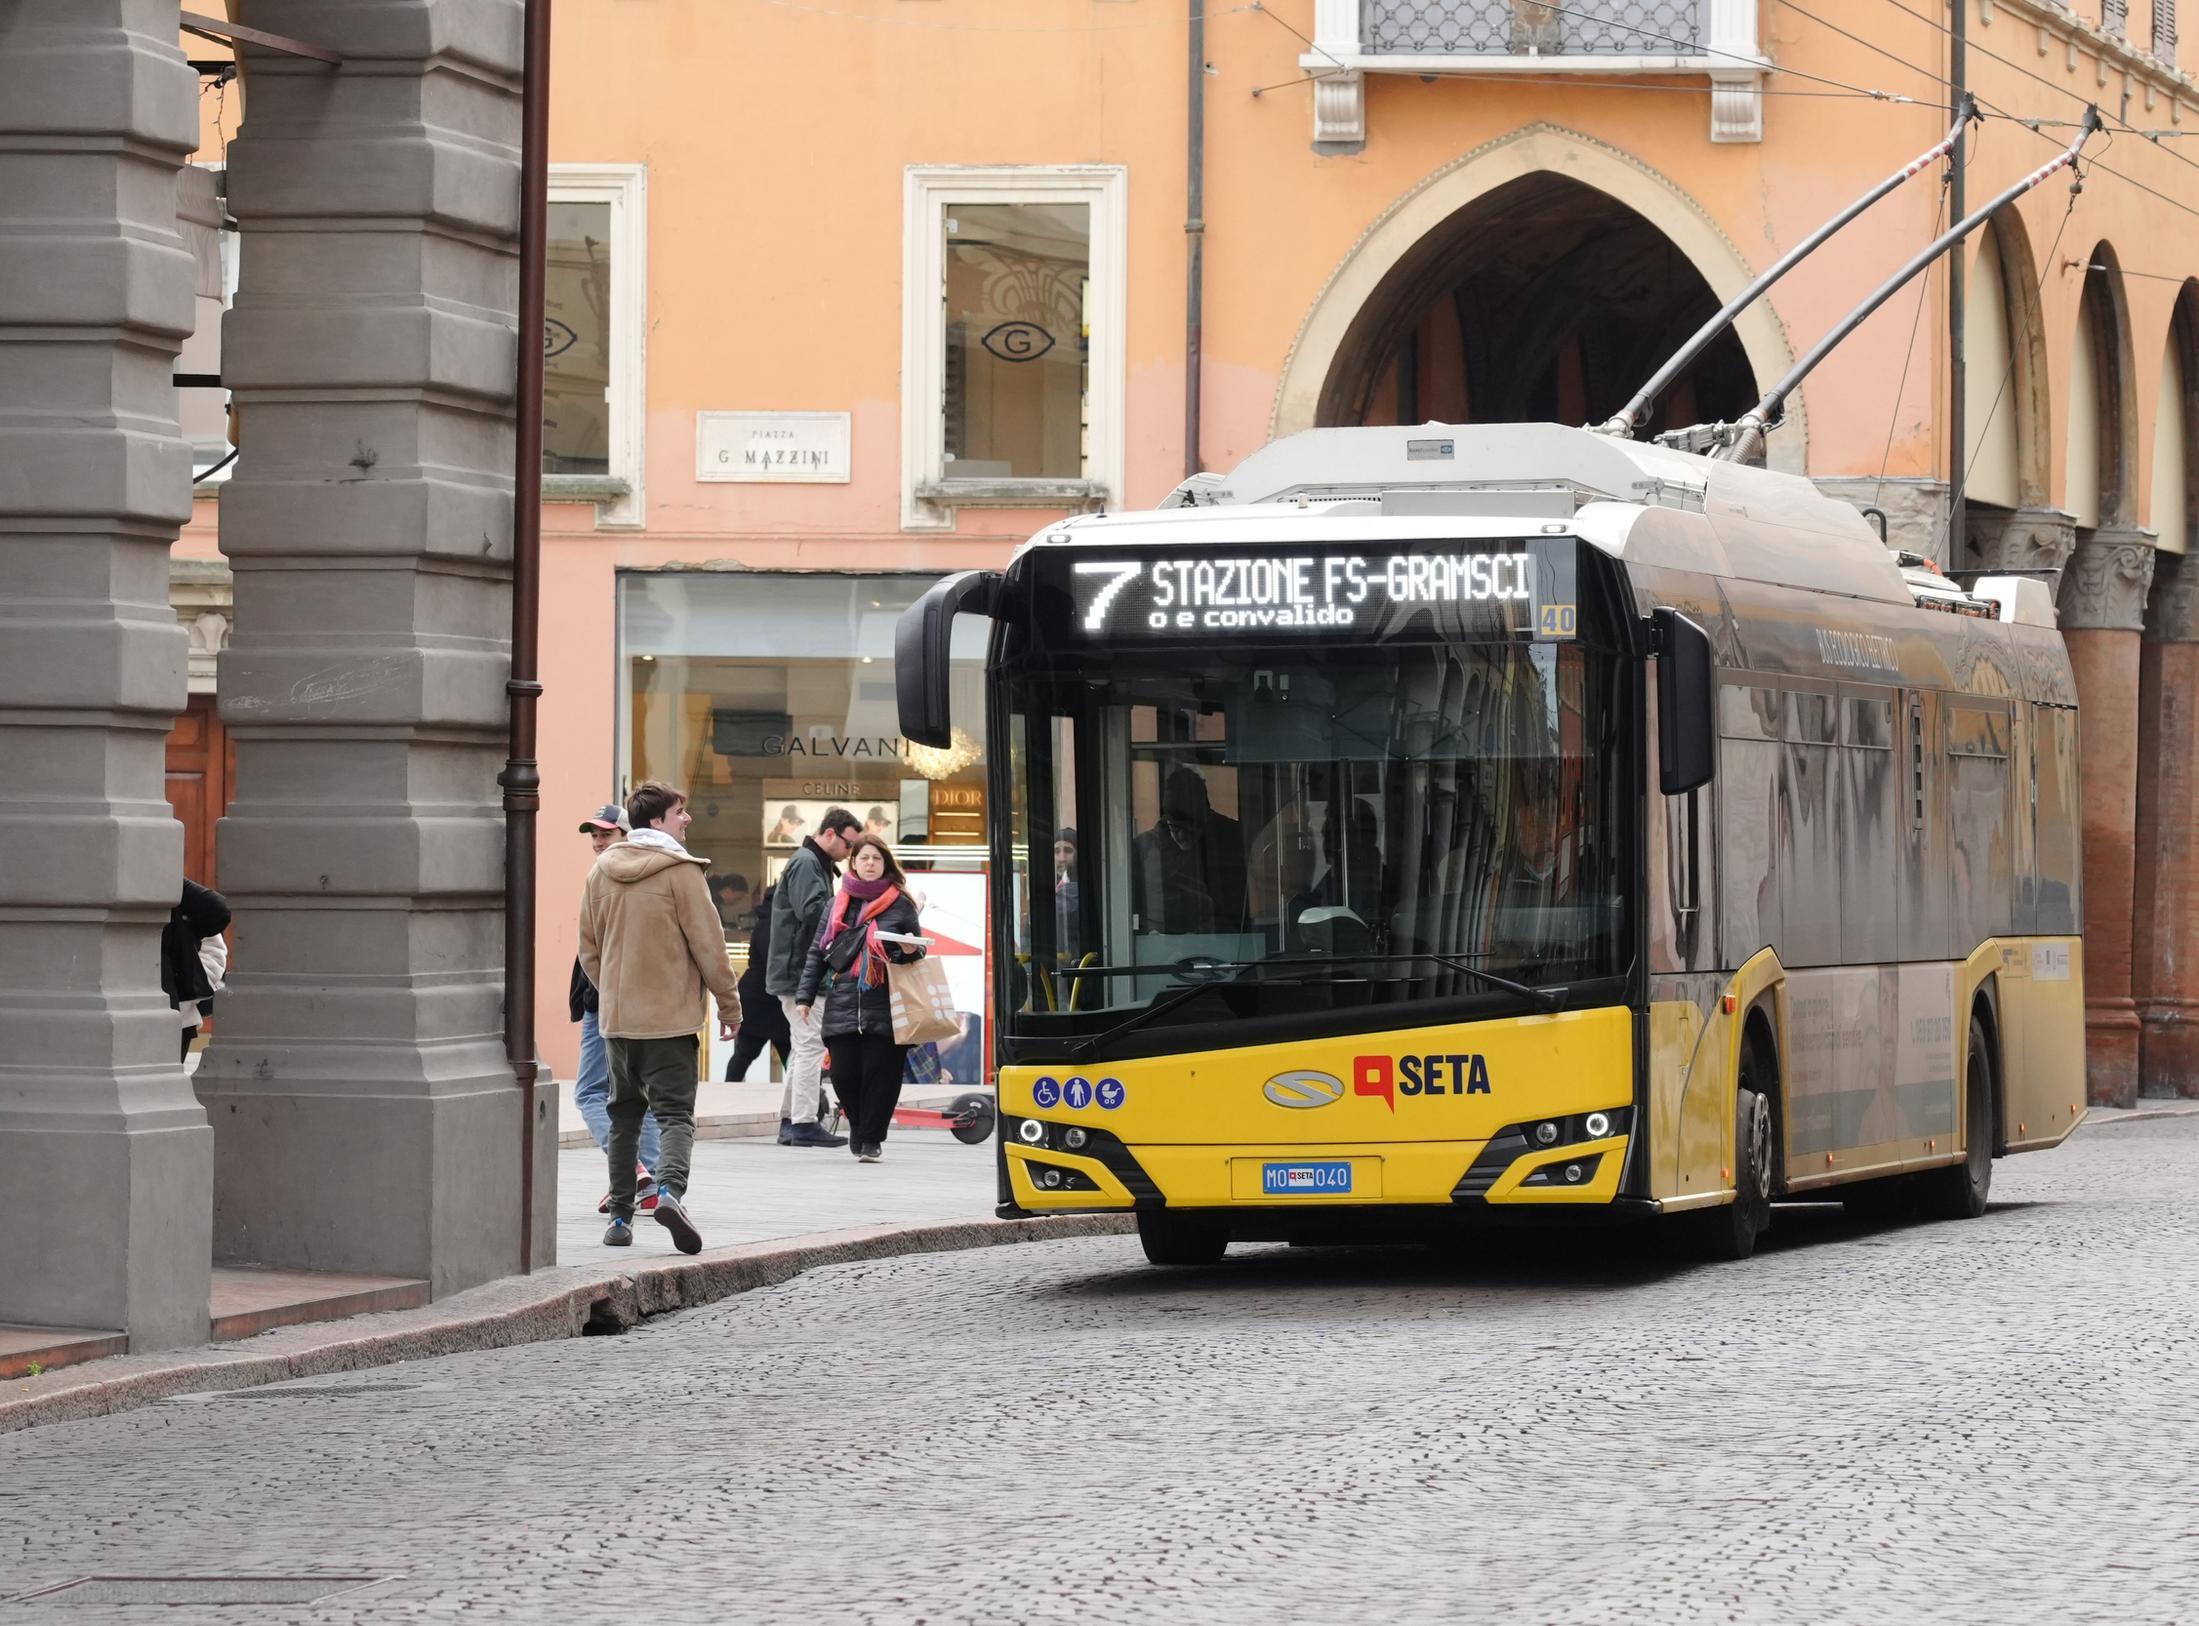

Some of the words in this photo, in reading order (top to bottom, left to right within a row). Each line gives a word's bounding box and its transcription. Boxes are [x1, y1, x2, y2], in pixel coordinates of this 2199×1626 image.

[1004, 329, 1031, 354] G
[752, 430, 794, 439] PIAZZA
[718, 449, 729, 464] G
[745, 450, 829, 465] MAZZINI
[1152, 557, 1314, 606] STAZIONE
[1324, 553, 1529, 603] FS-GRAMSCI
[1074, 561, 1141, 630] 7
[1149, 611, 1168, 628] o
[1176, 611, 1195, 627] e
[1204, 602, 1354, 627] convalido
[1542, 607, 1575, 632] 40
[761, 736, 910, 757] GALVANI
[802, 782, 862, 796] CELINE
[934, 790, 982, 806] DIOR
[1398, 1054, 1491, 1096] SETA
[1266, 1169, 1287, 1188] MO
[1297, 1171, 1314, 1180] SETA
[1316, 1168, 1348, 1187] 040
